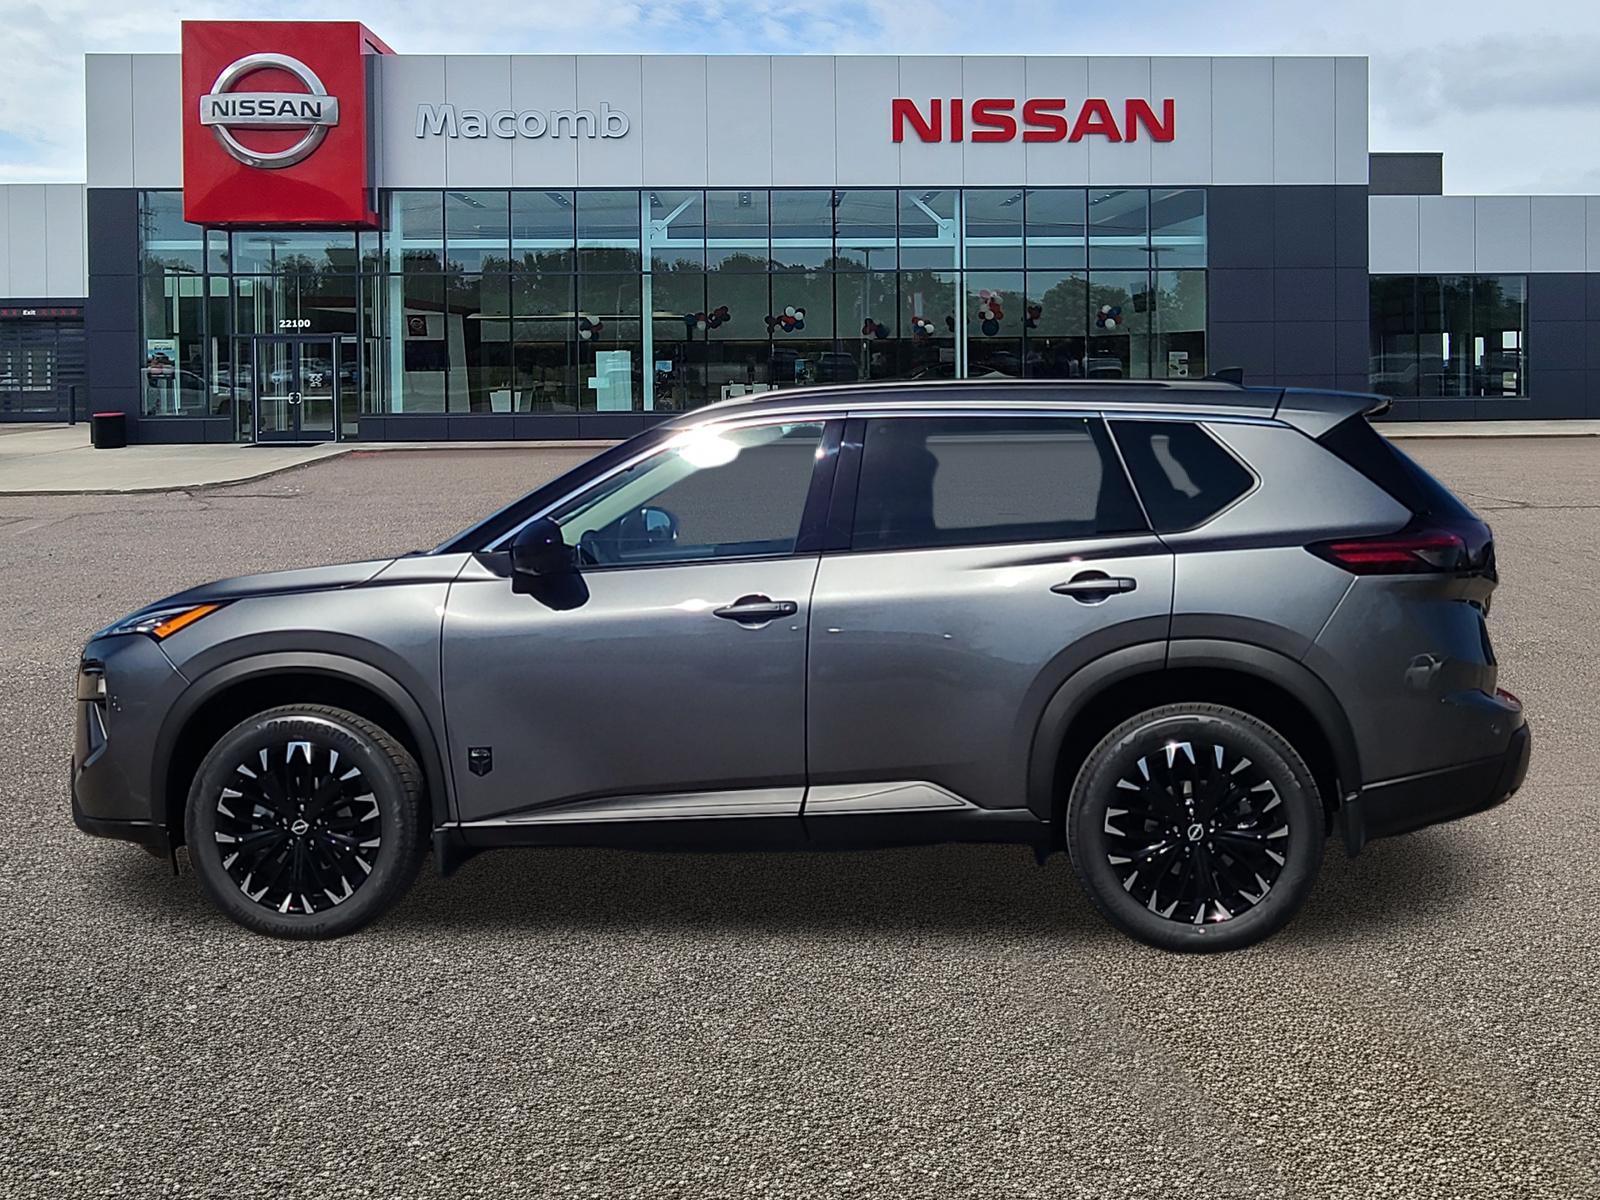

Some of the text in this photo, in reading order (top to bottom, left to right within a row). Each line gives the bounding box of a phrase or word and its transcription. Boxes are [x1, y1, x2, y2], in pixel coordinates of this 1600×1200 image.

[212, 99, 322, 119] NISSAN
[415, 102, 630, 139] Macomb
[892, 98, 1176, 143] NISSAN
[279, 319, 311, 328] 22100
